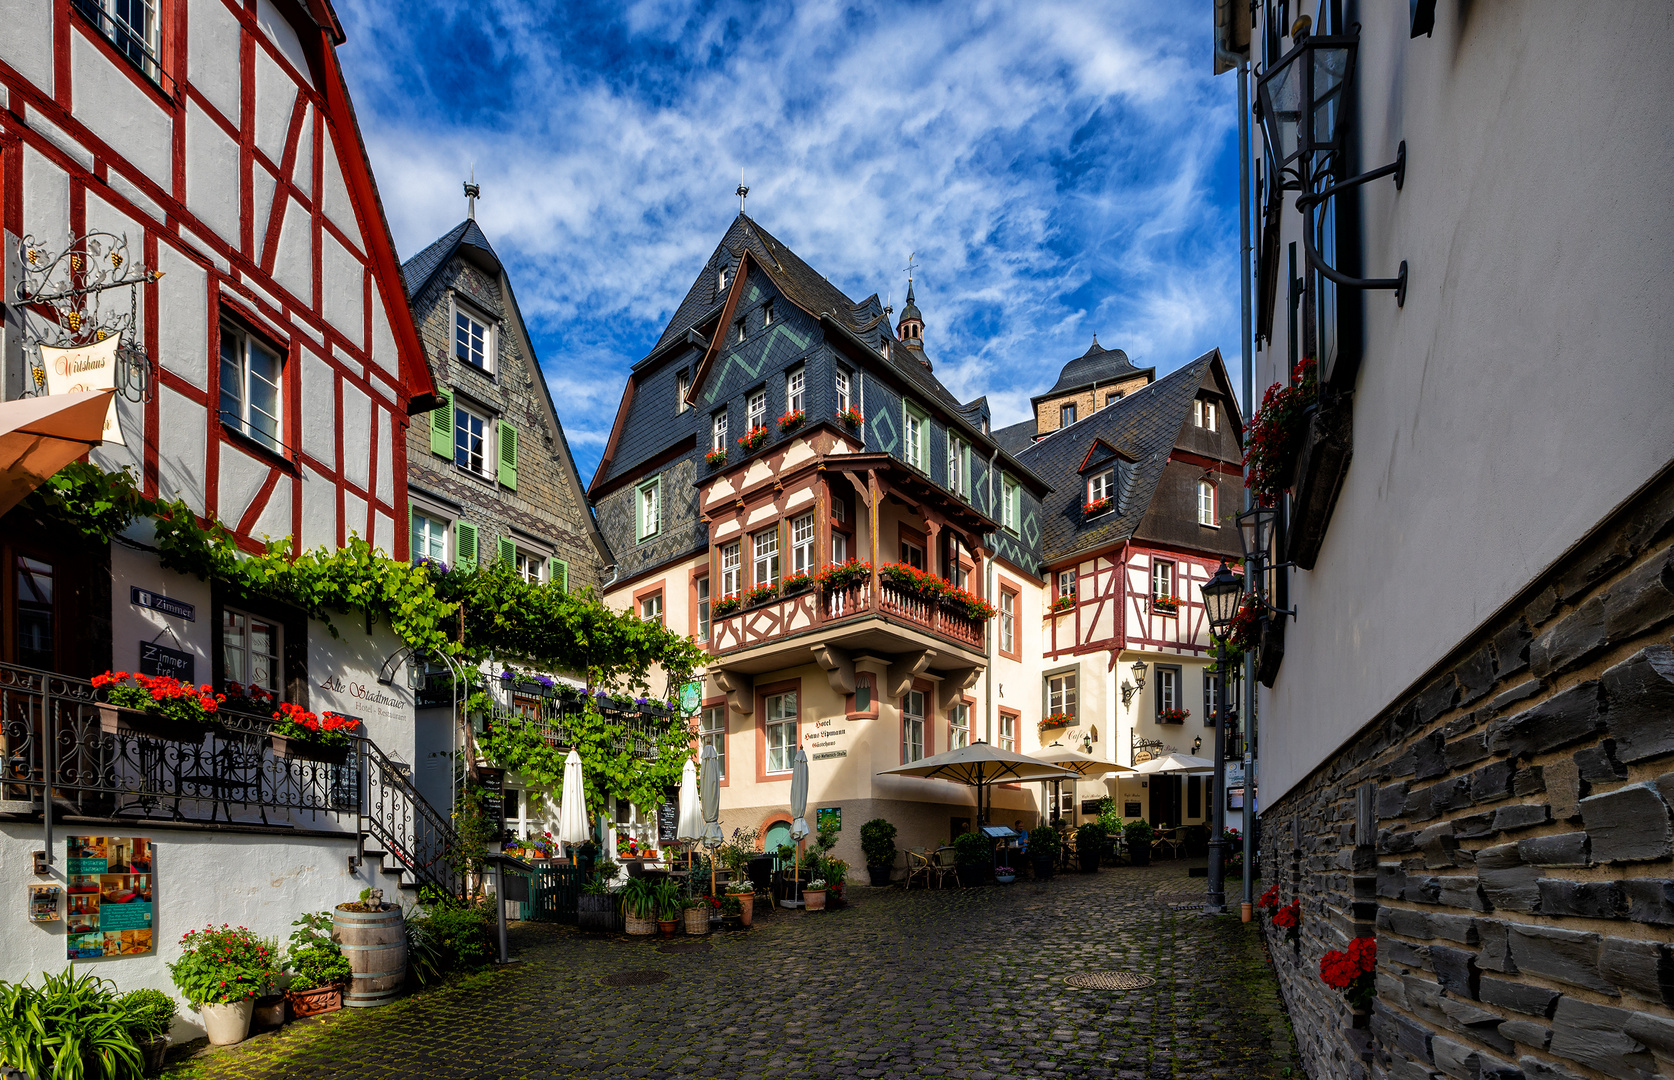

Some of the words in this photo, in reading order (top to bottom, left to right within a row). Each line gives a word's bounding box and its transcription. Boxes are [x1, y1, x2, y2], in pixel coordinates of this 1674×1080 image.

[55, 354, 106, 377] Wirtshaus
[156, 597, 192, 618] Zimmer
[142, 645, 188, 669] Zimmer
[156, 662, 175, 678] frei
[320, 675, 346, 694] Alte
[349, 681, 406, 710] Stadtmauer
[355, 701, 373, 714] Hotel
[377, 707, 407, 722] Restaurant
